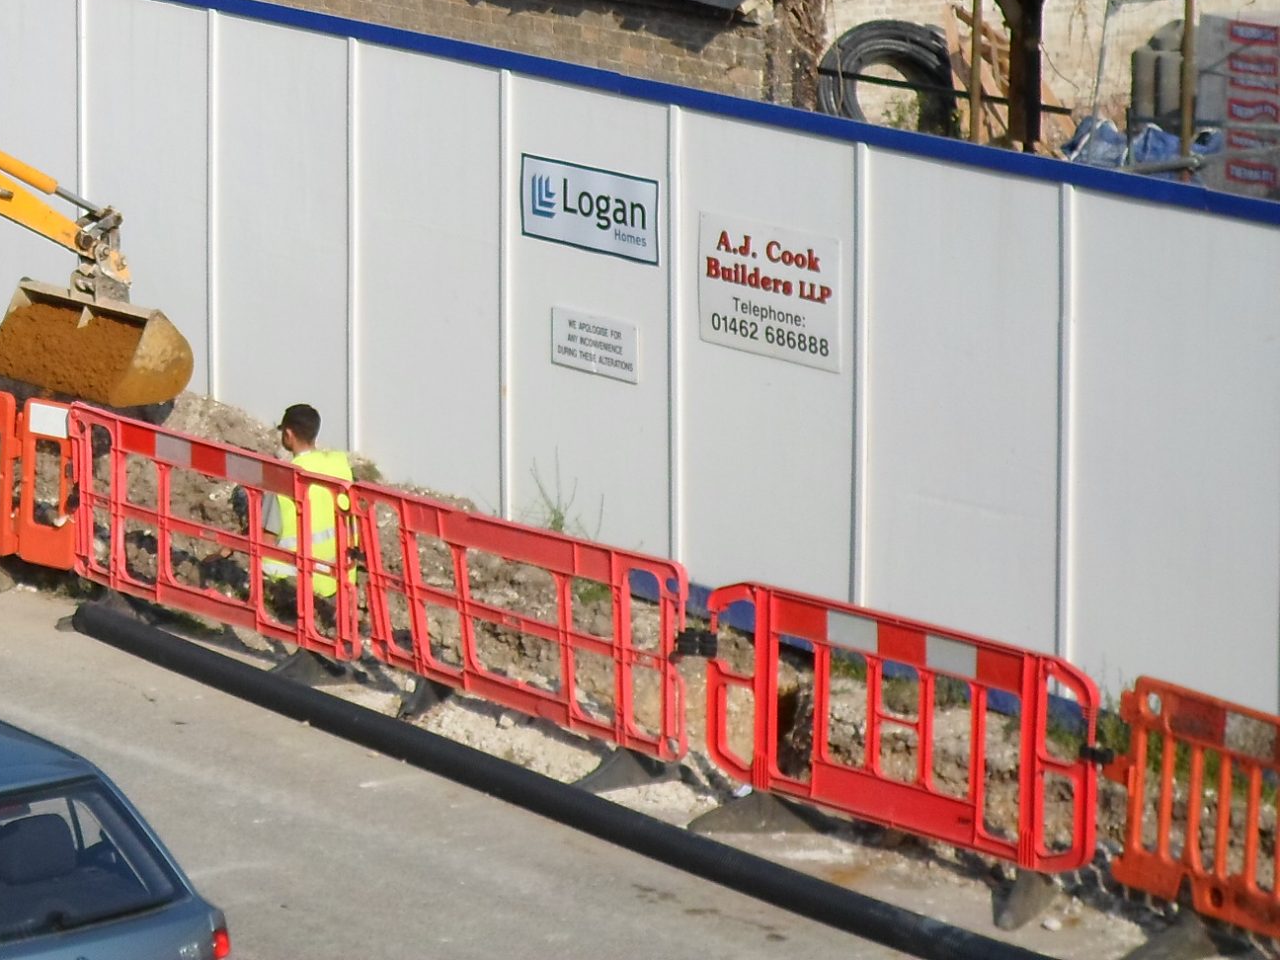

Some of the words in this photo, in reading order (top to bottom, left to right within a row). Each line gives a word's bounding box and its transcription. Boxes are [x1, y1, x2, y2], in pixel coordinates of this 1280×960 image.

[563, 177, 646, 231] Logan
[614, 228, 647, 247] Homes
[716, 230, 758, 258] A.J.
[766, 240, 821, 273] Cook
[706, 256, 793, 296] Builders
[798, 280, 833, 304] LLP
[732, 296, 806, 328] Telephone:
[567, 333, 578, 342] ANY
[568, 319, 577, 330] WE
[610, 329, 622, 340] FOR
[711, 312, 759, 341] 01462
[765, 325, 830, 357] 686888
[557, 344, 578, 358] DURING
[579, 350, 597, 363] THESE
[598, 355, 634, 372] ALTERATIONS
